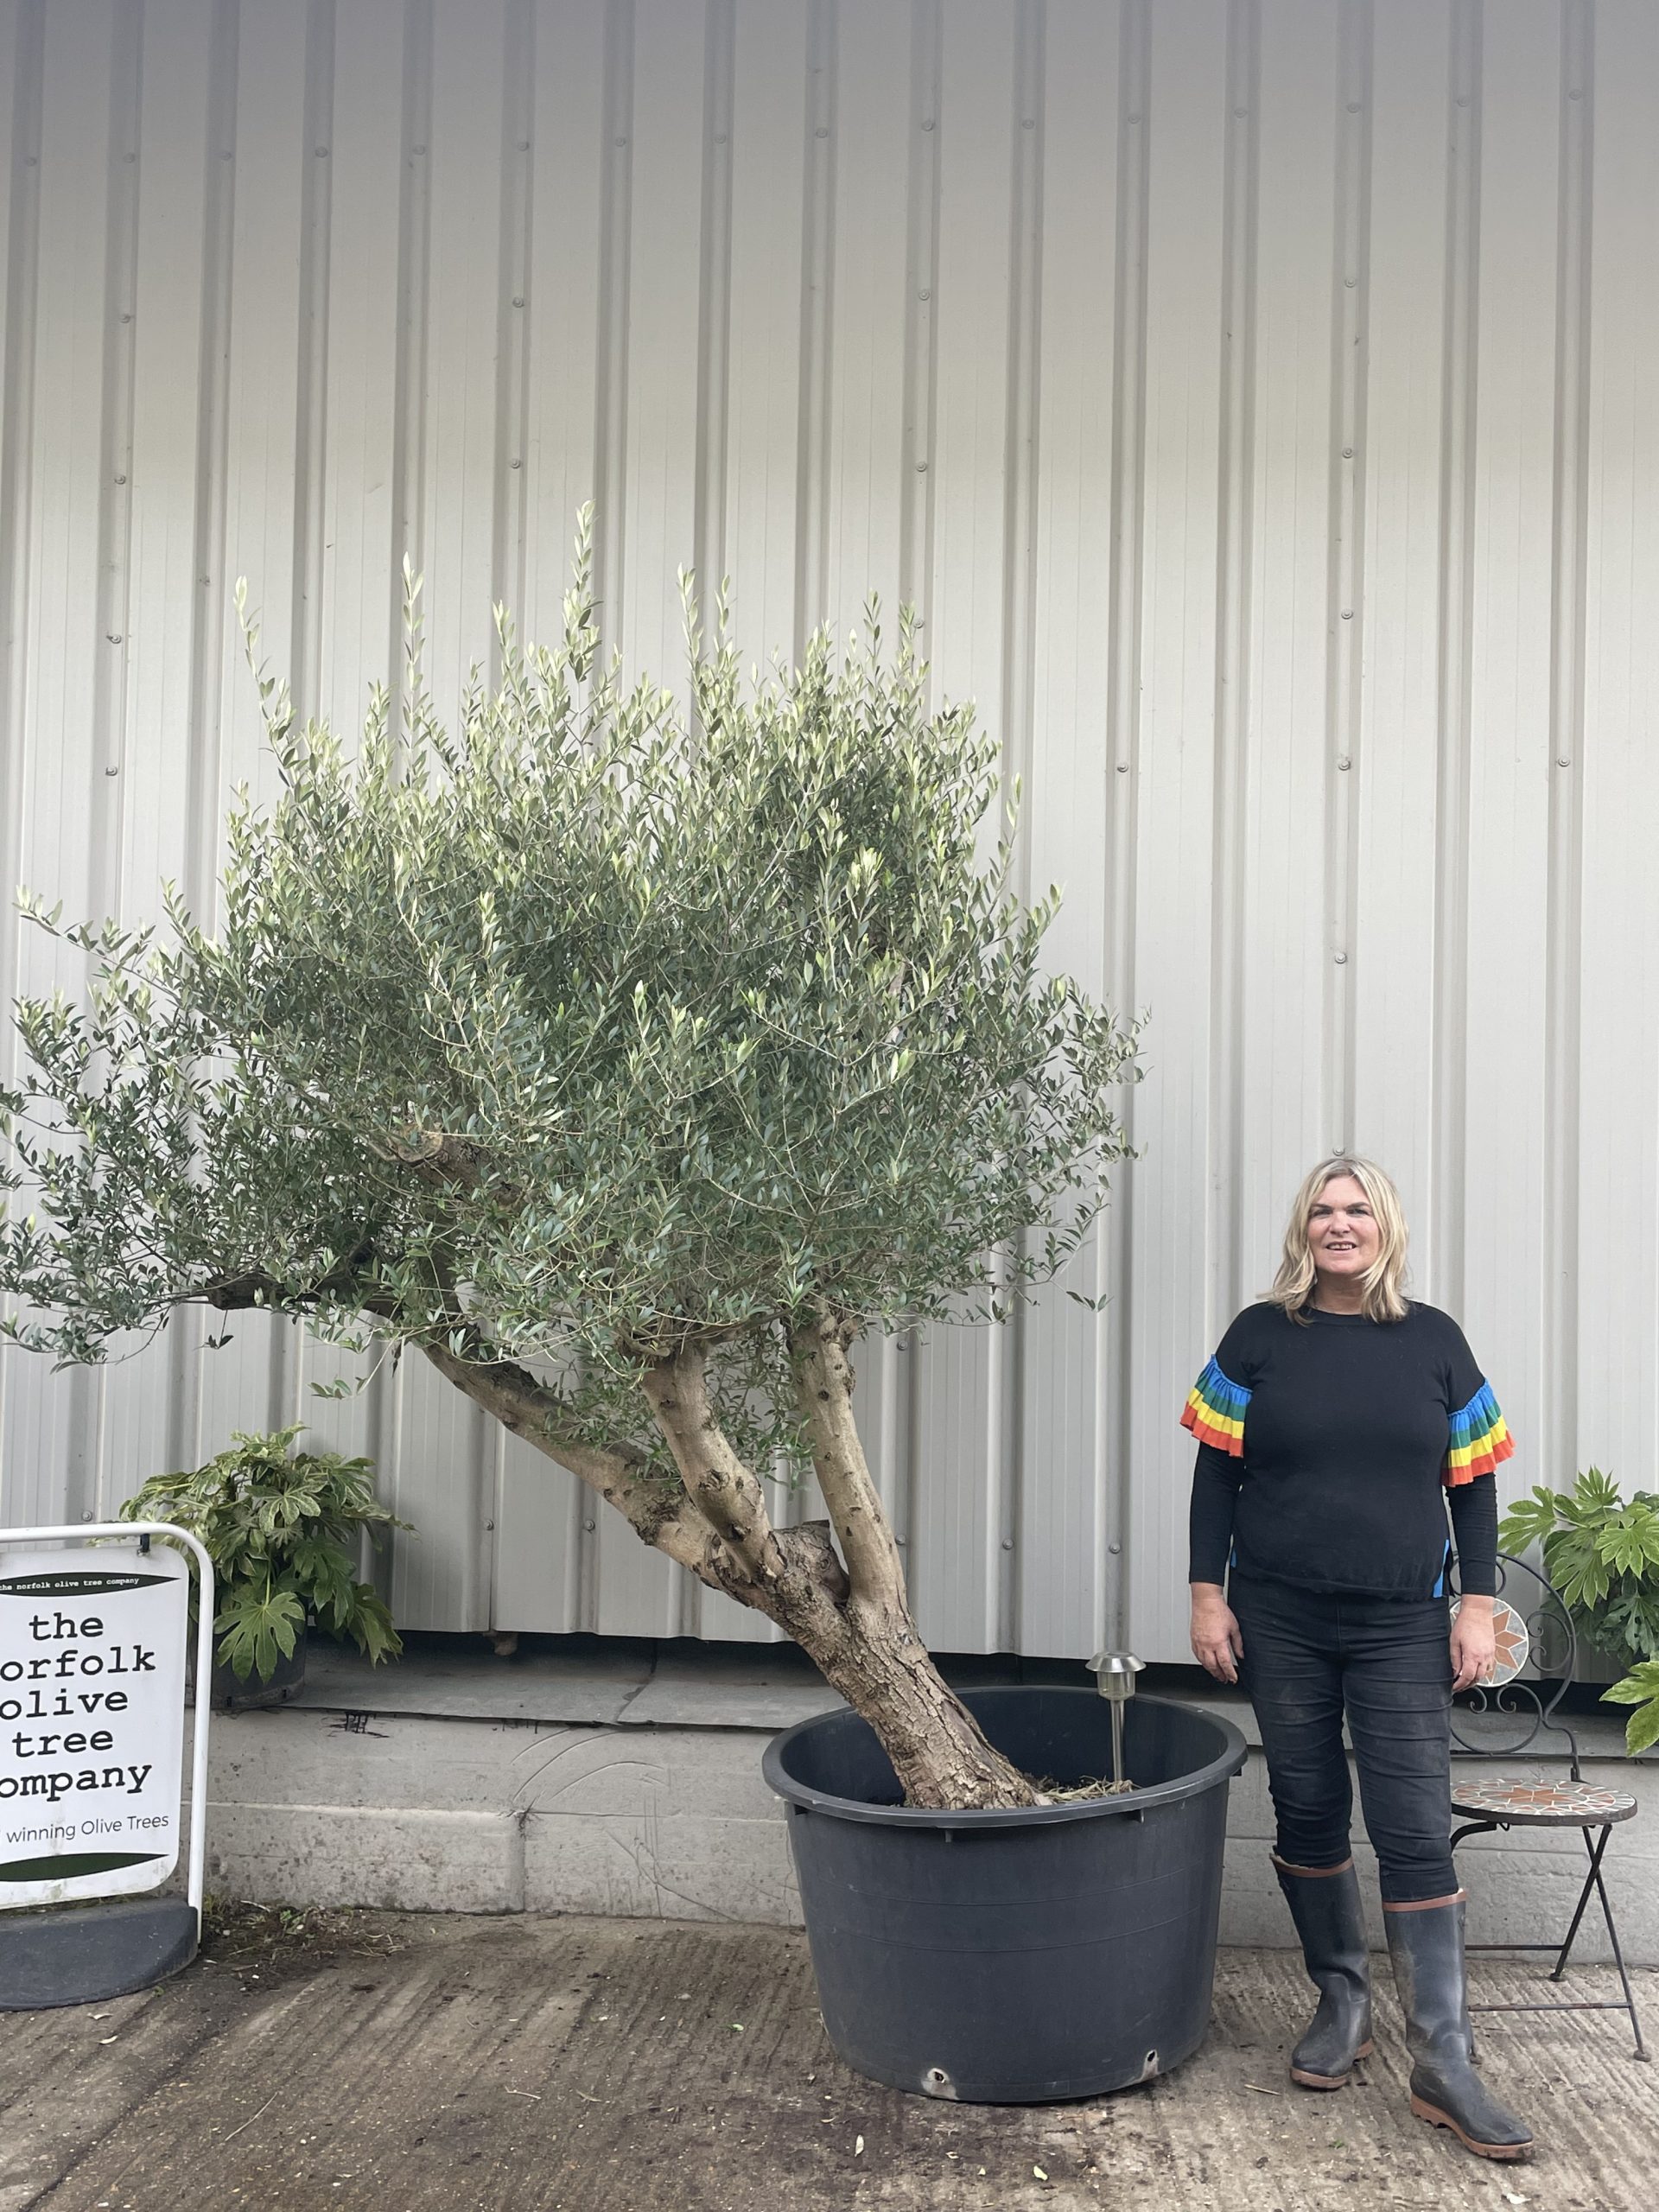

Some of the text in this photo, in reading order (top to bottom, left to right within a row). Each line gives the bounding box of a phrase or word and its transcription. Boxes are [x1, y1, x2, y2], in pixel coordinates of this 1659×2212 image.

[29, 1612, 104, 1641] the
[0, 1645, 156, 1681] orfolk
[0, 1688, 128, 1720] olive
[12, 1731, 113, 1758] tree
[0, 1764, 152, 1802] ompany
[6, 1815, 169, 1843] winning Olive Trees
